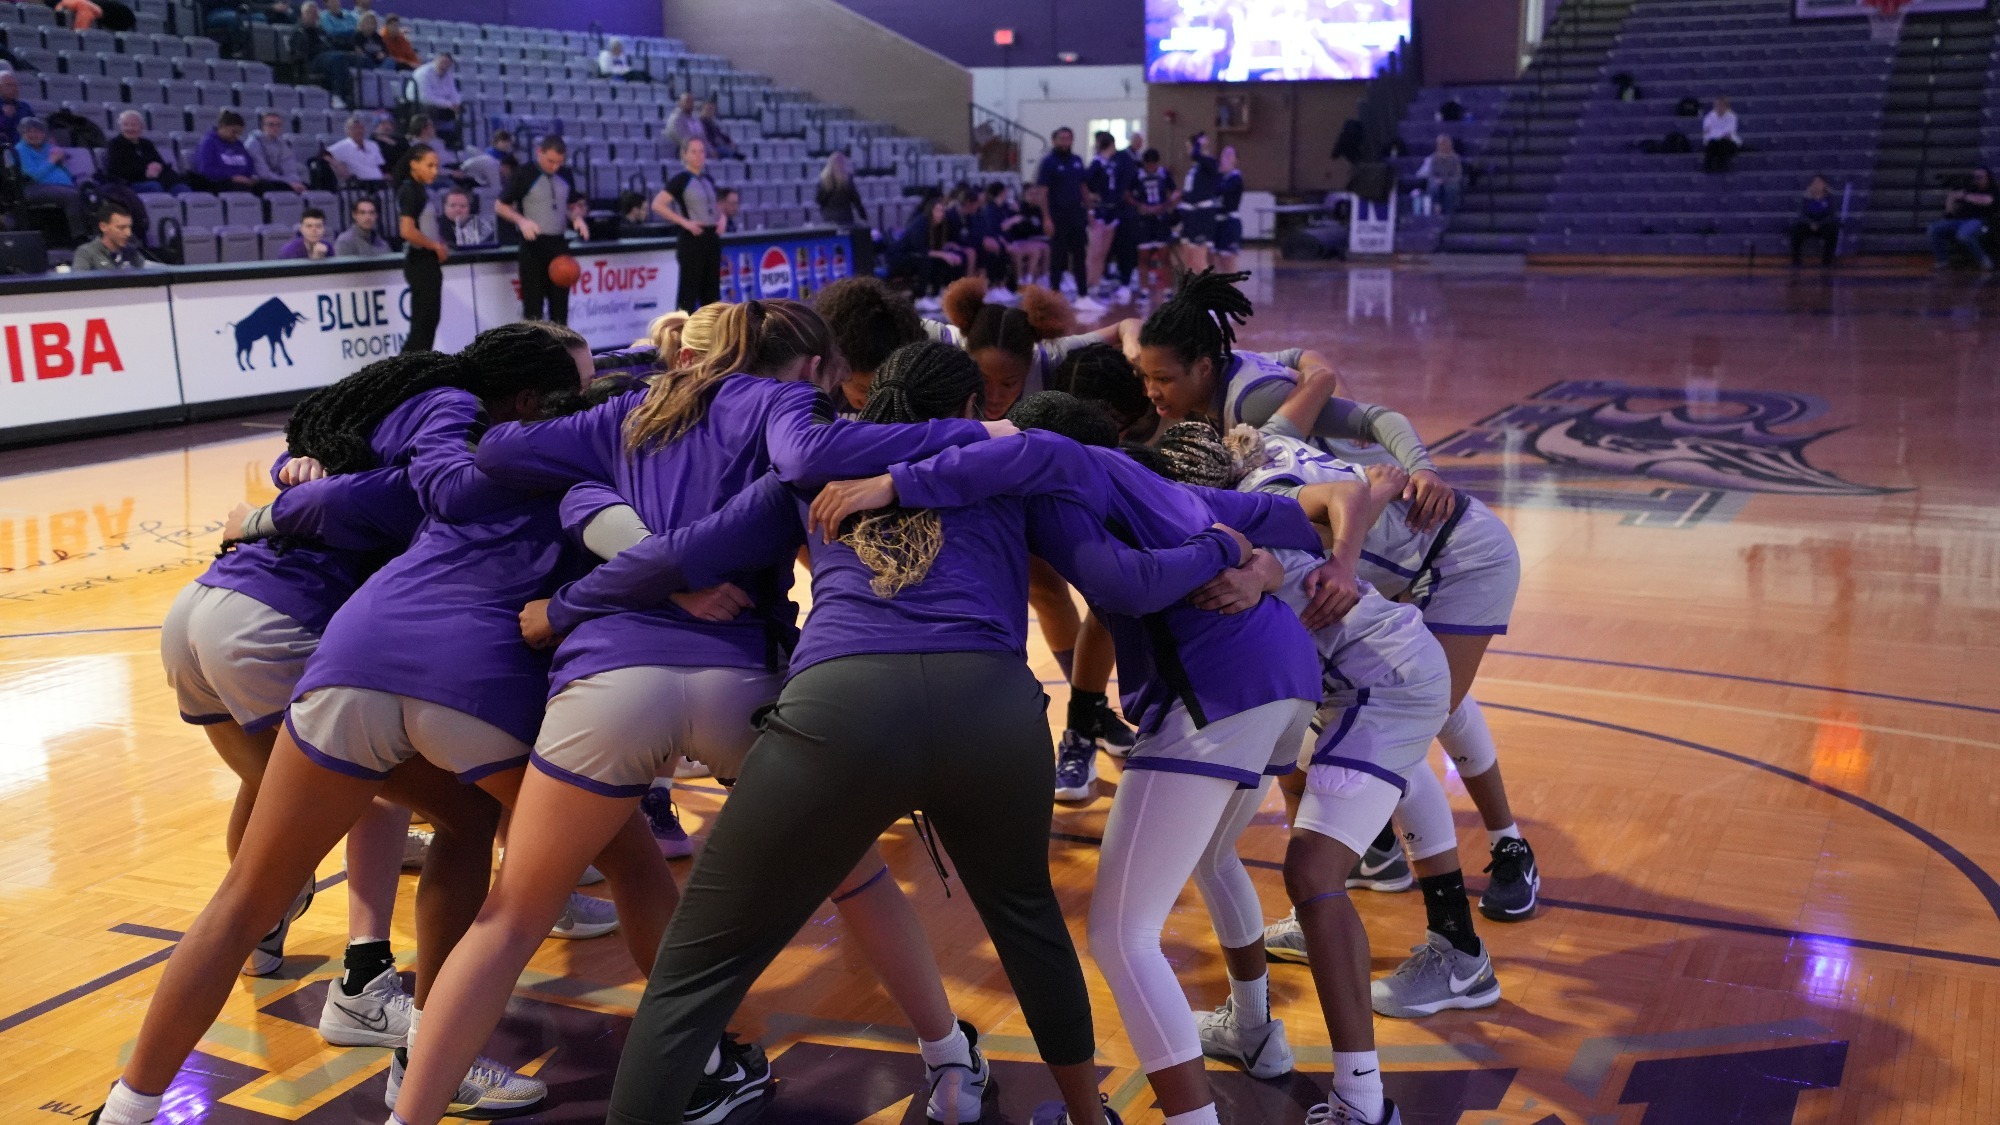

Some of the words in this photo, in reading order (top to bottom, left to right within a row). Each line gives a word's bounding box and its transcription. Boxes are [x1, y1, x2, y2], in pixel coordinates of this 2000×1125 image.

[594, 259, 646, 293] Tours
[317, 289, 388, 331] BLUE
[341, 333, 411, 359] ROOFIN
